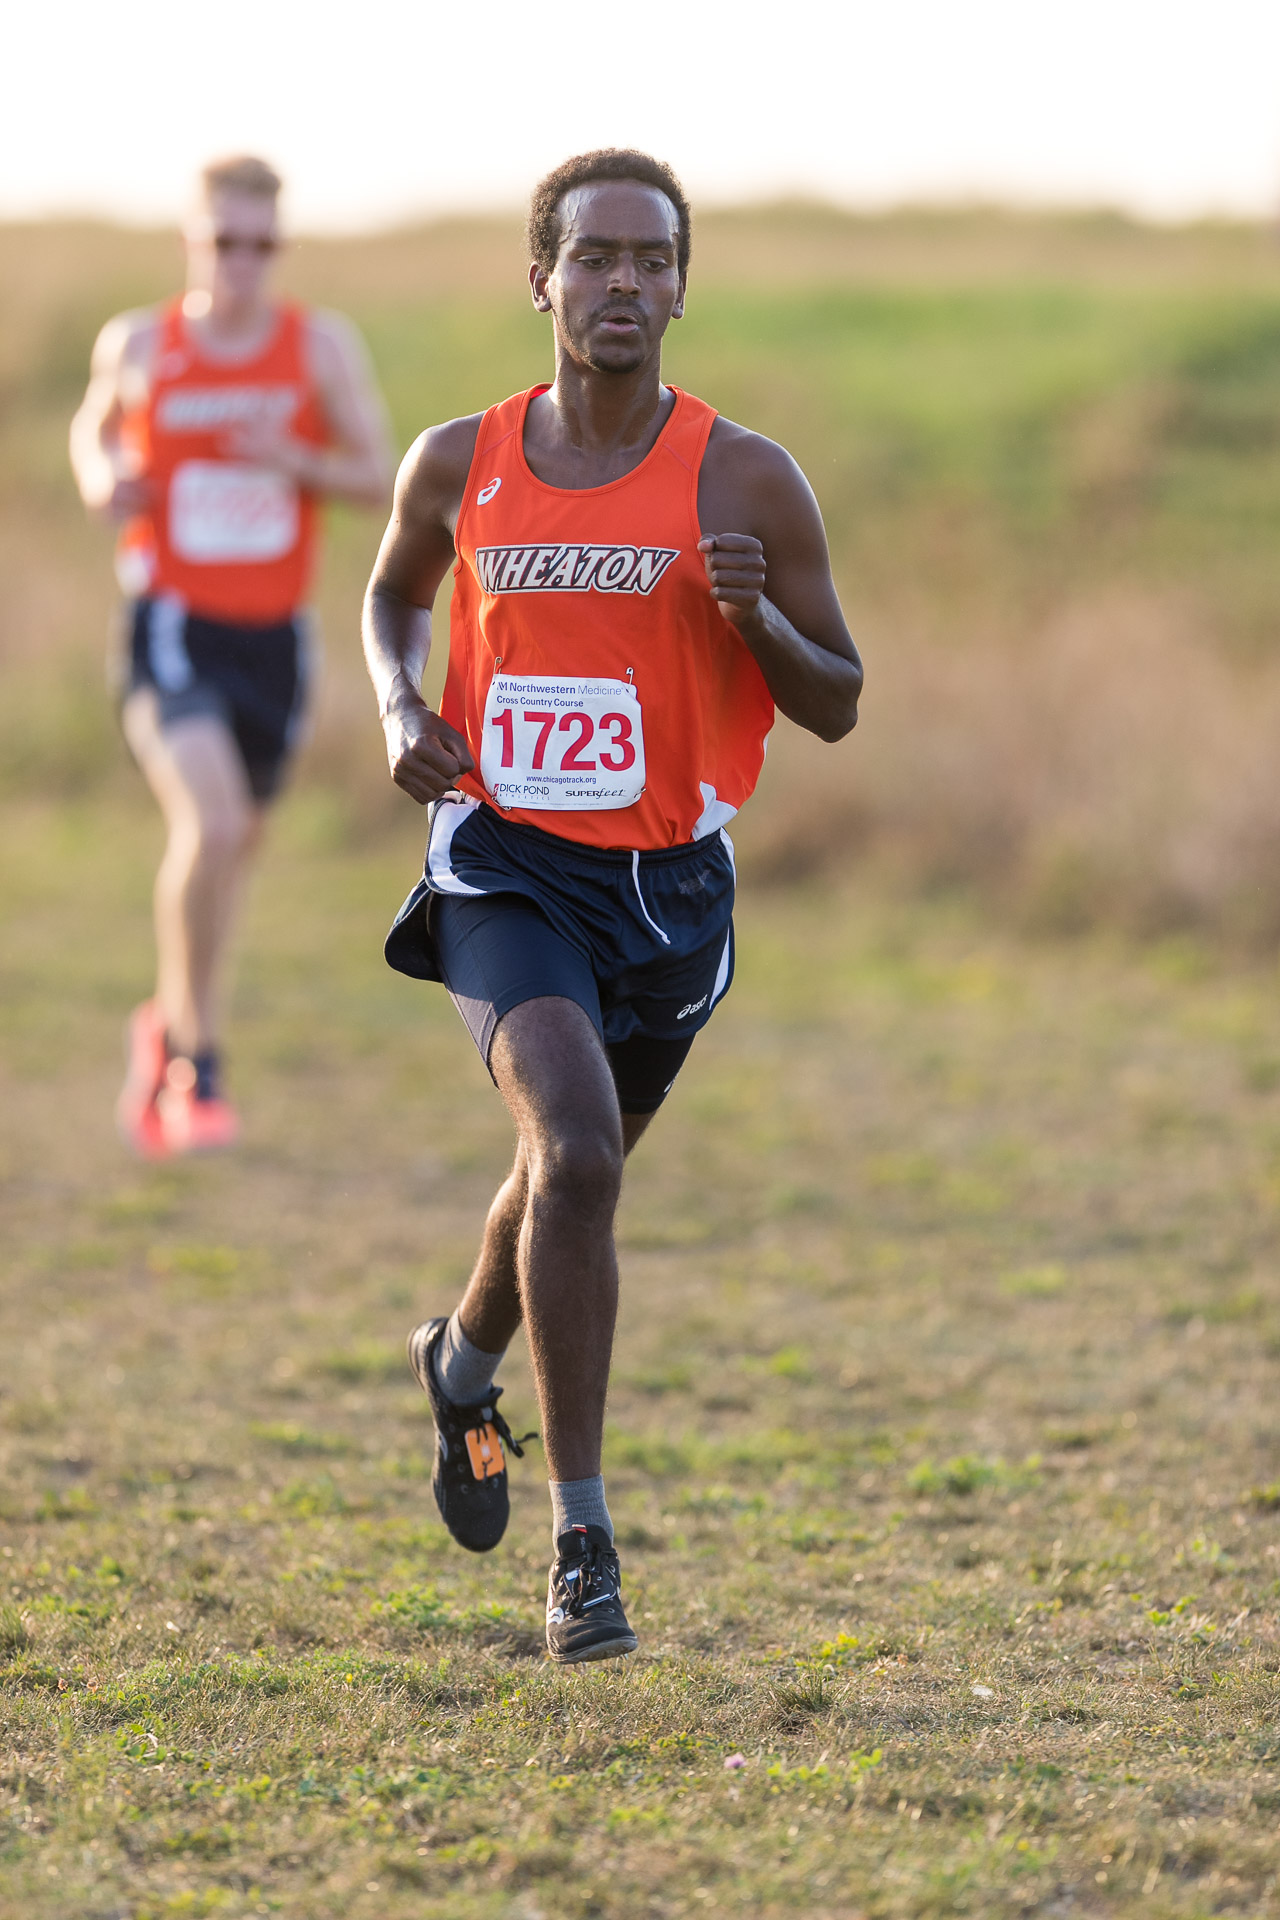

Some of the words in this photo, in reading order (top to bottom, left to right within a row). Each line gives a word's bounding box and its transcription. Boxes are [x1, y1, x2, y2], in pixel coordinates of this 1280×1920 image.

[475, 543, 681, 596] WHEATON
[509, 682, 576, 694] Northwestern
[577, 685, 622, 696] Medicine
[496, 695, 519, 705] Cross
[520, 696, 553, 708] Country
[553, 698, 584, 707] Course
[491, 708, 636, 772] 1723
[526, 775, 597, 785] www.chicagotrack.org
[499, 783, 522, 794] DICK
[523, 785, 550, 796] POND
